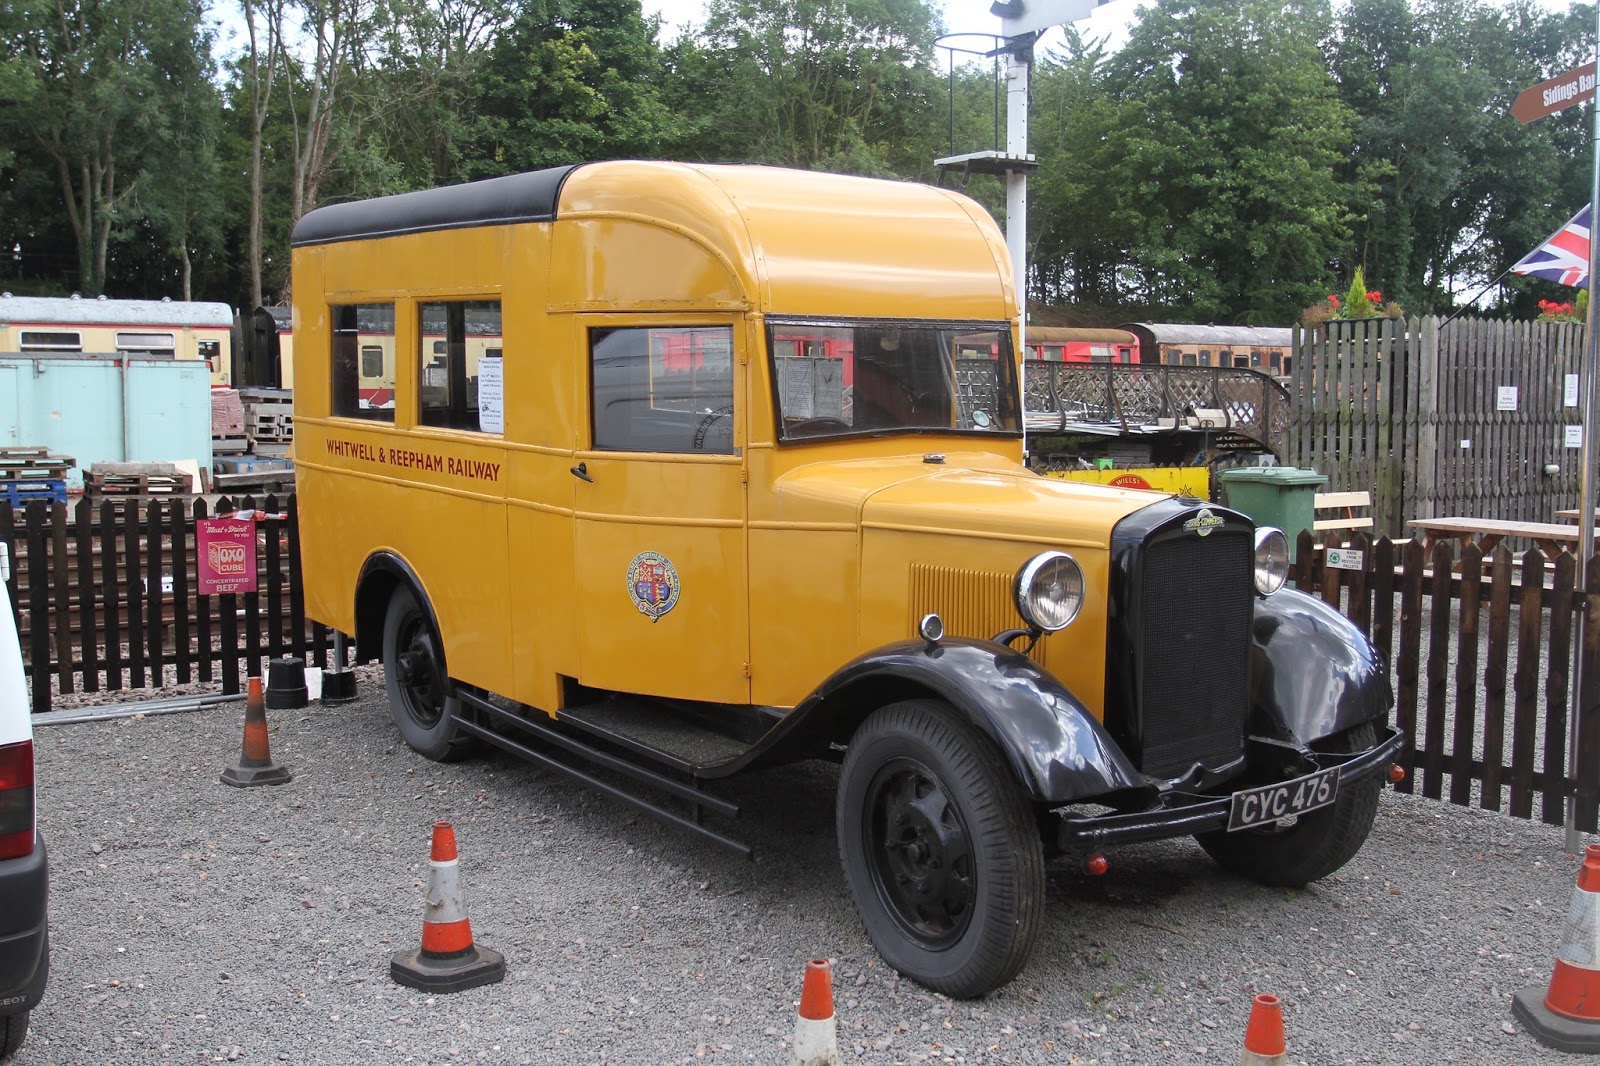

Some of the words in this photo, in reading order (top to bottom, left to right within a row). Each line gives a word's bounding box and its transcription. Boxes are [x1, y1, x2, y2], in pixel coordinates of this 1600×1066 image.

[1542, 81, 1578, 107] Sidings
[326, 438, 376, 462] WHITWELL
[378, 447, 386, 464] &
[389, 448, 443, 473] REEPHAM
[447, 457, 501, 482] RAILWAY
[220, 549, 244, 563] OXO
[221, 564, 244, 572] CUBE
[216, 584, 239, 592] BEEF
[1241, 788, 1288, 823] CYC
[1292, 774, 1330, 810] 476
